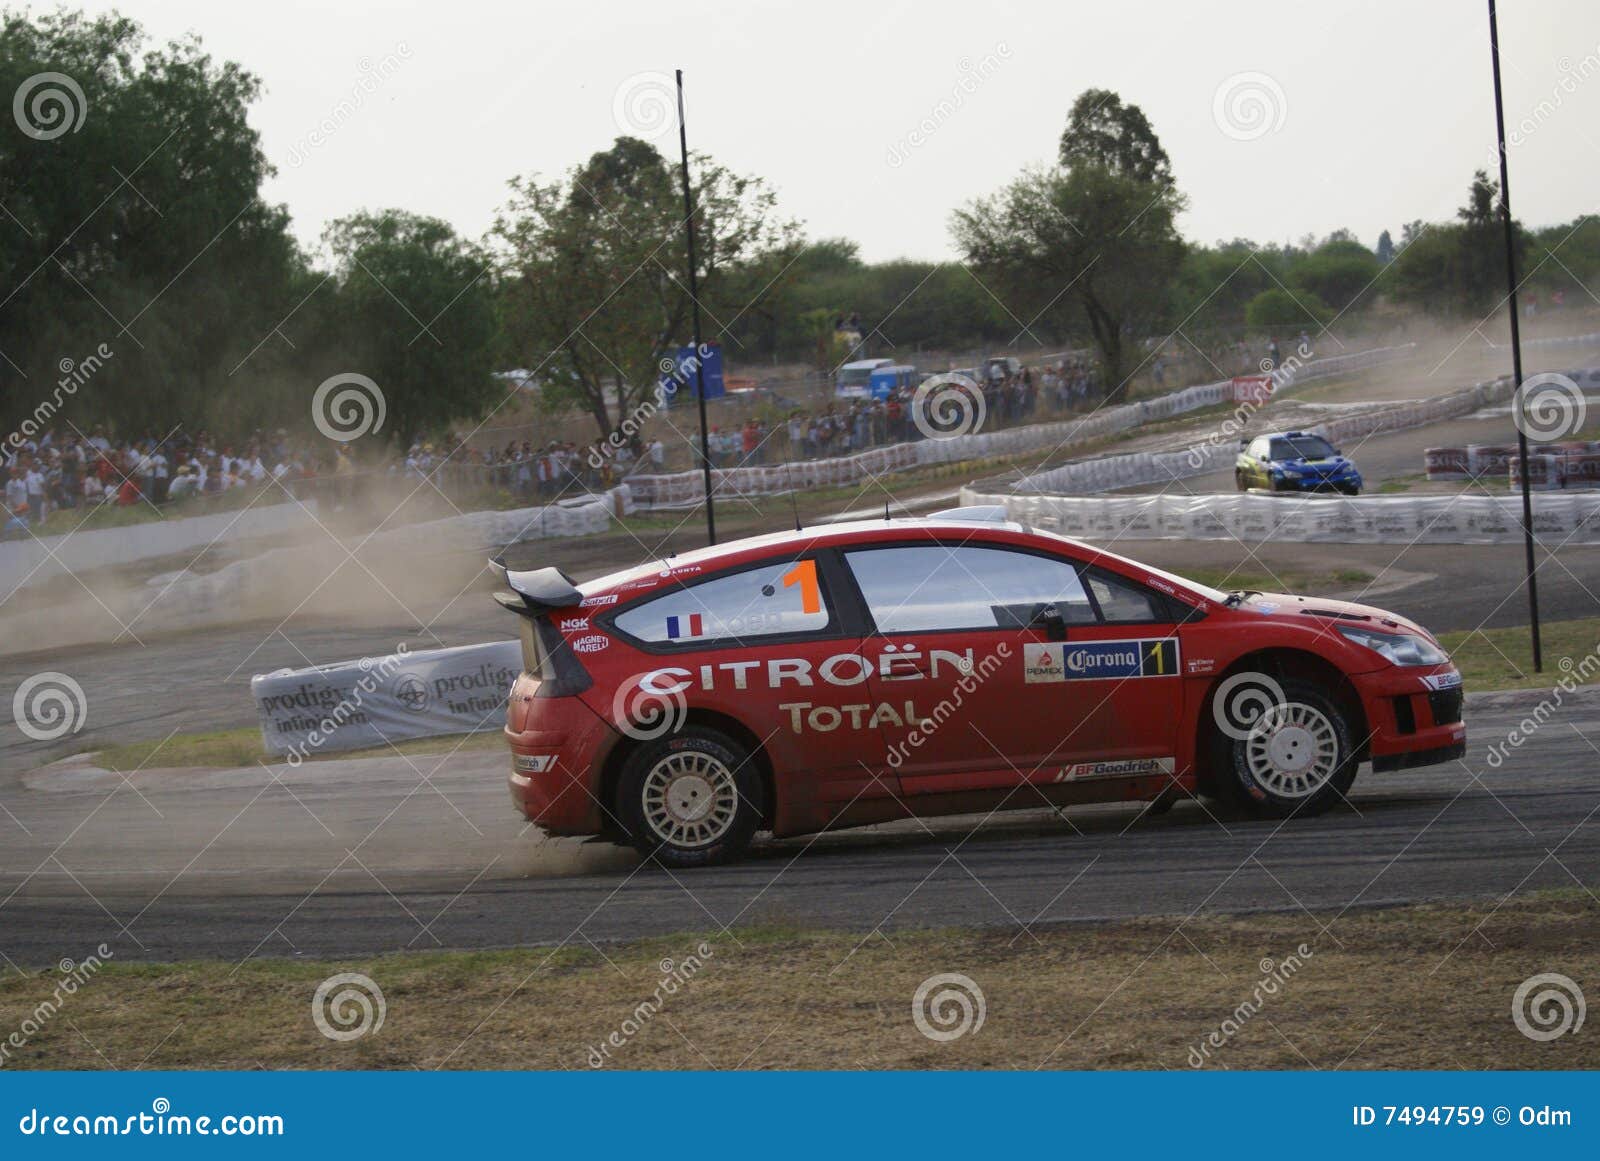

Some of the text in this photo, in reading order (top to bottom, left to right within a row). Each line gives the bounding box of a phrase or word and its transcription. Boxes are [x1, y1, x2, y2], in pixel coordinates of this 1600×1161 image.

[783, 560, 821, 614] 1
[560, 617, 589, 629] NGK
[638, 643, 975, 696] CITROËN
[1026, 666, 1063, 676] PEMEX
[1067, 648, 1137, 673] Corona
[1151, 641, 1164, 674] 1
[779, 700, 932, 735] TOTAL
[1074, 759, 1160, 776] BFGoodrich
